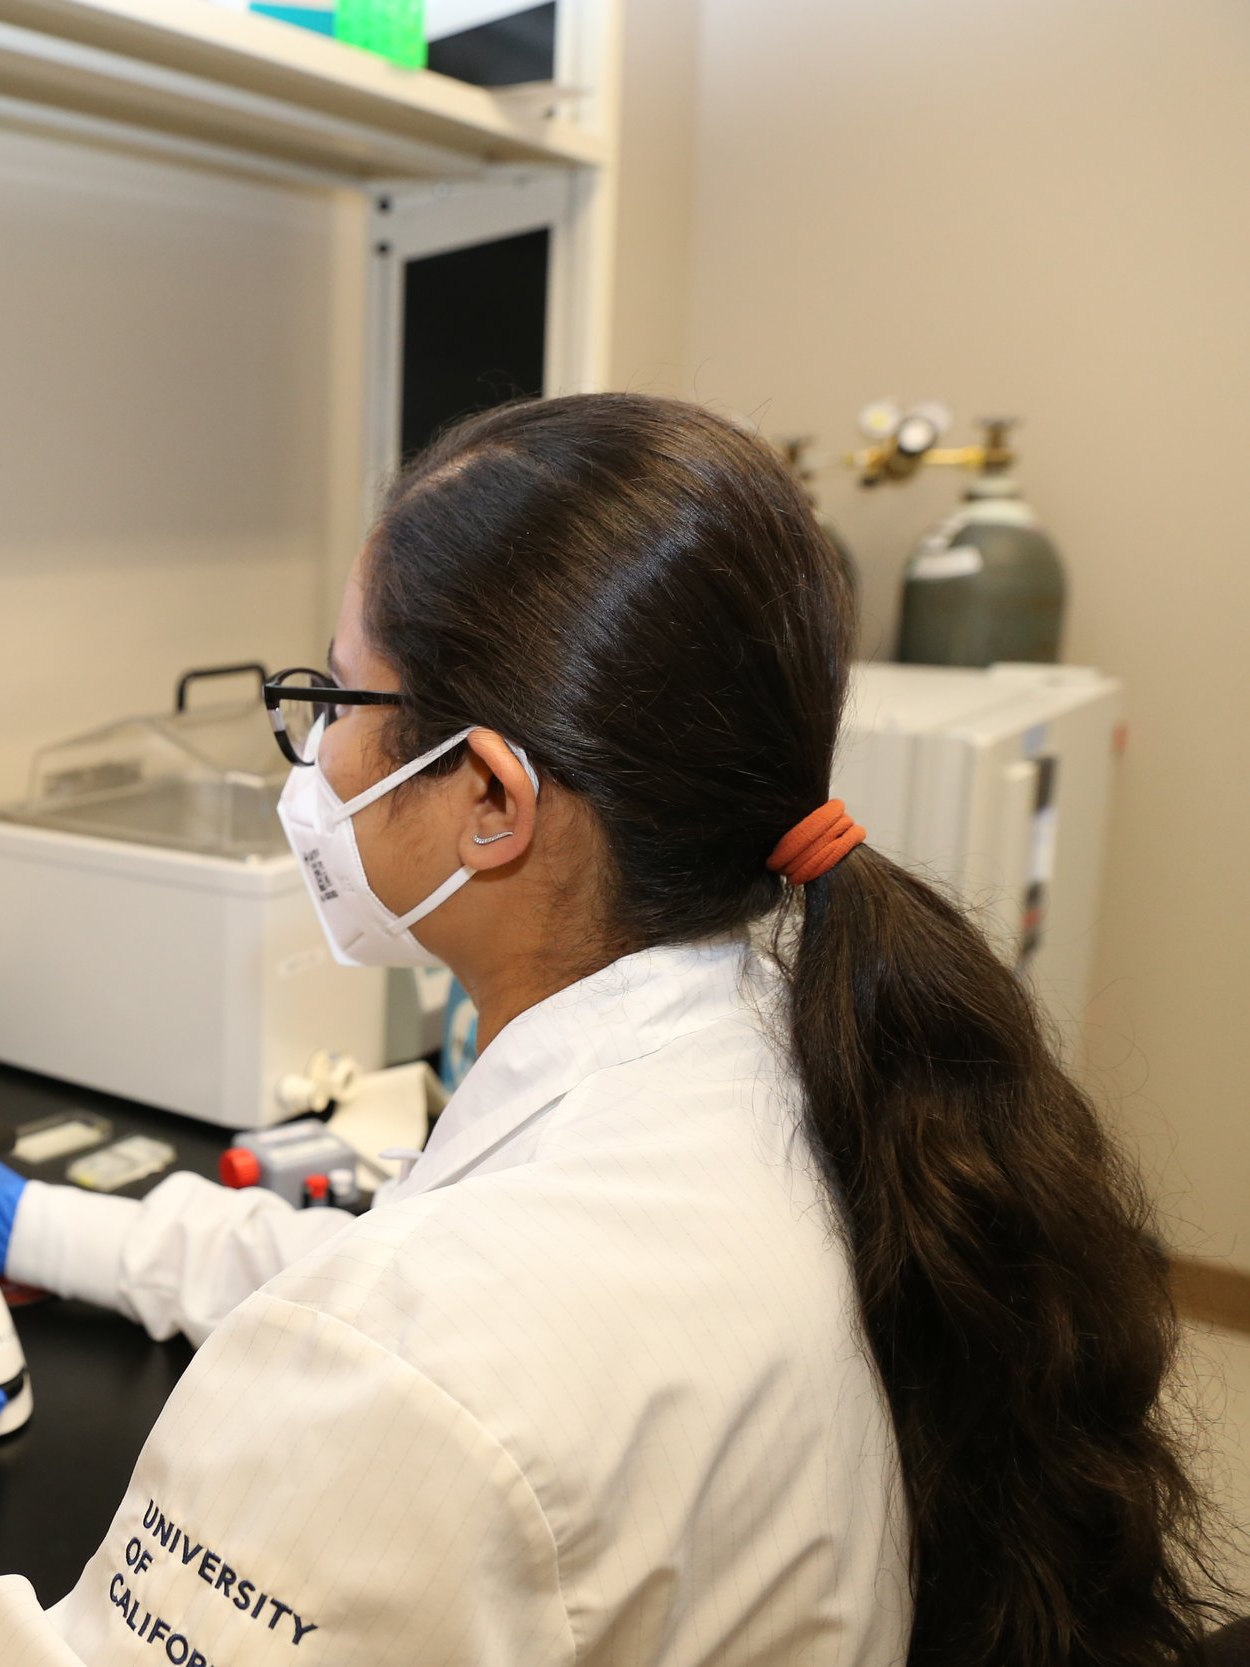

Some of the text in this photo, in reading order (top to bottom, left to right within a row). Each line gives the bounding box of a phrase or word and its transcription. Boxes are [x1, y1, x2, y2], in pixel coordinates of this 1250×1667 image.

[125, 1536, 153, 1575] OF
[142, 1499, 318, 1646] UNIVERSITY
[109, 1572, 214, 1667] CALIFOR
